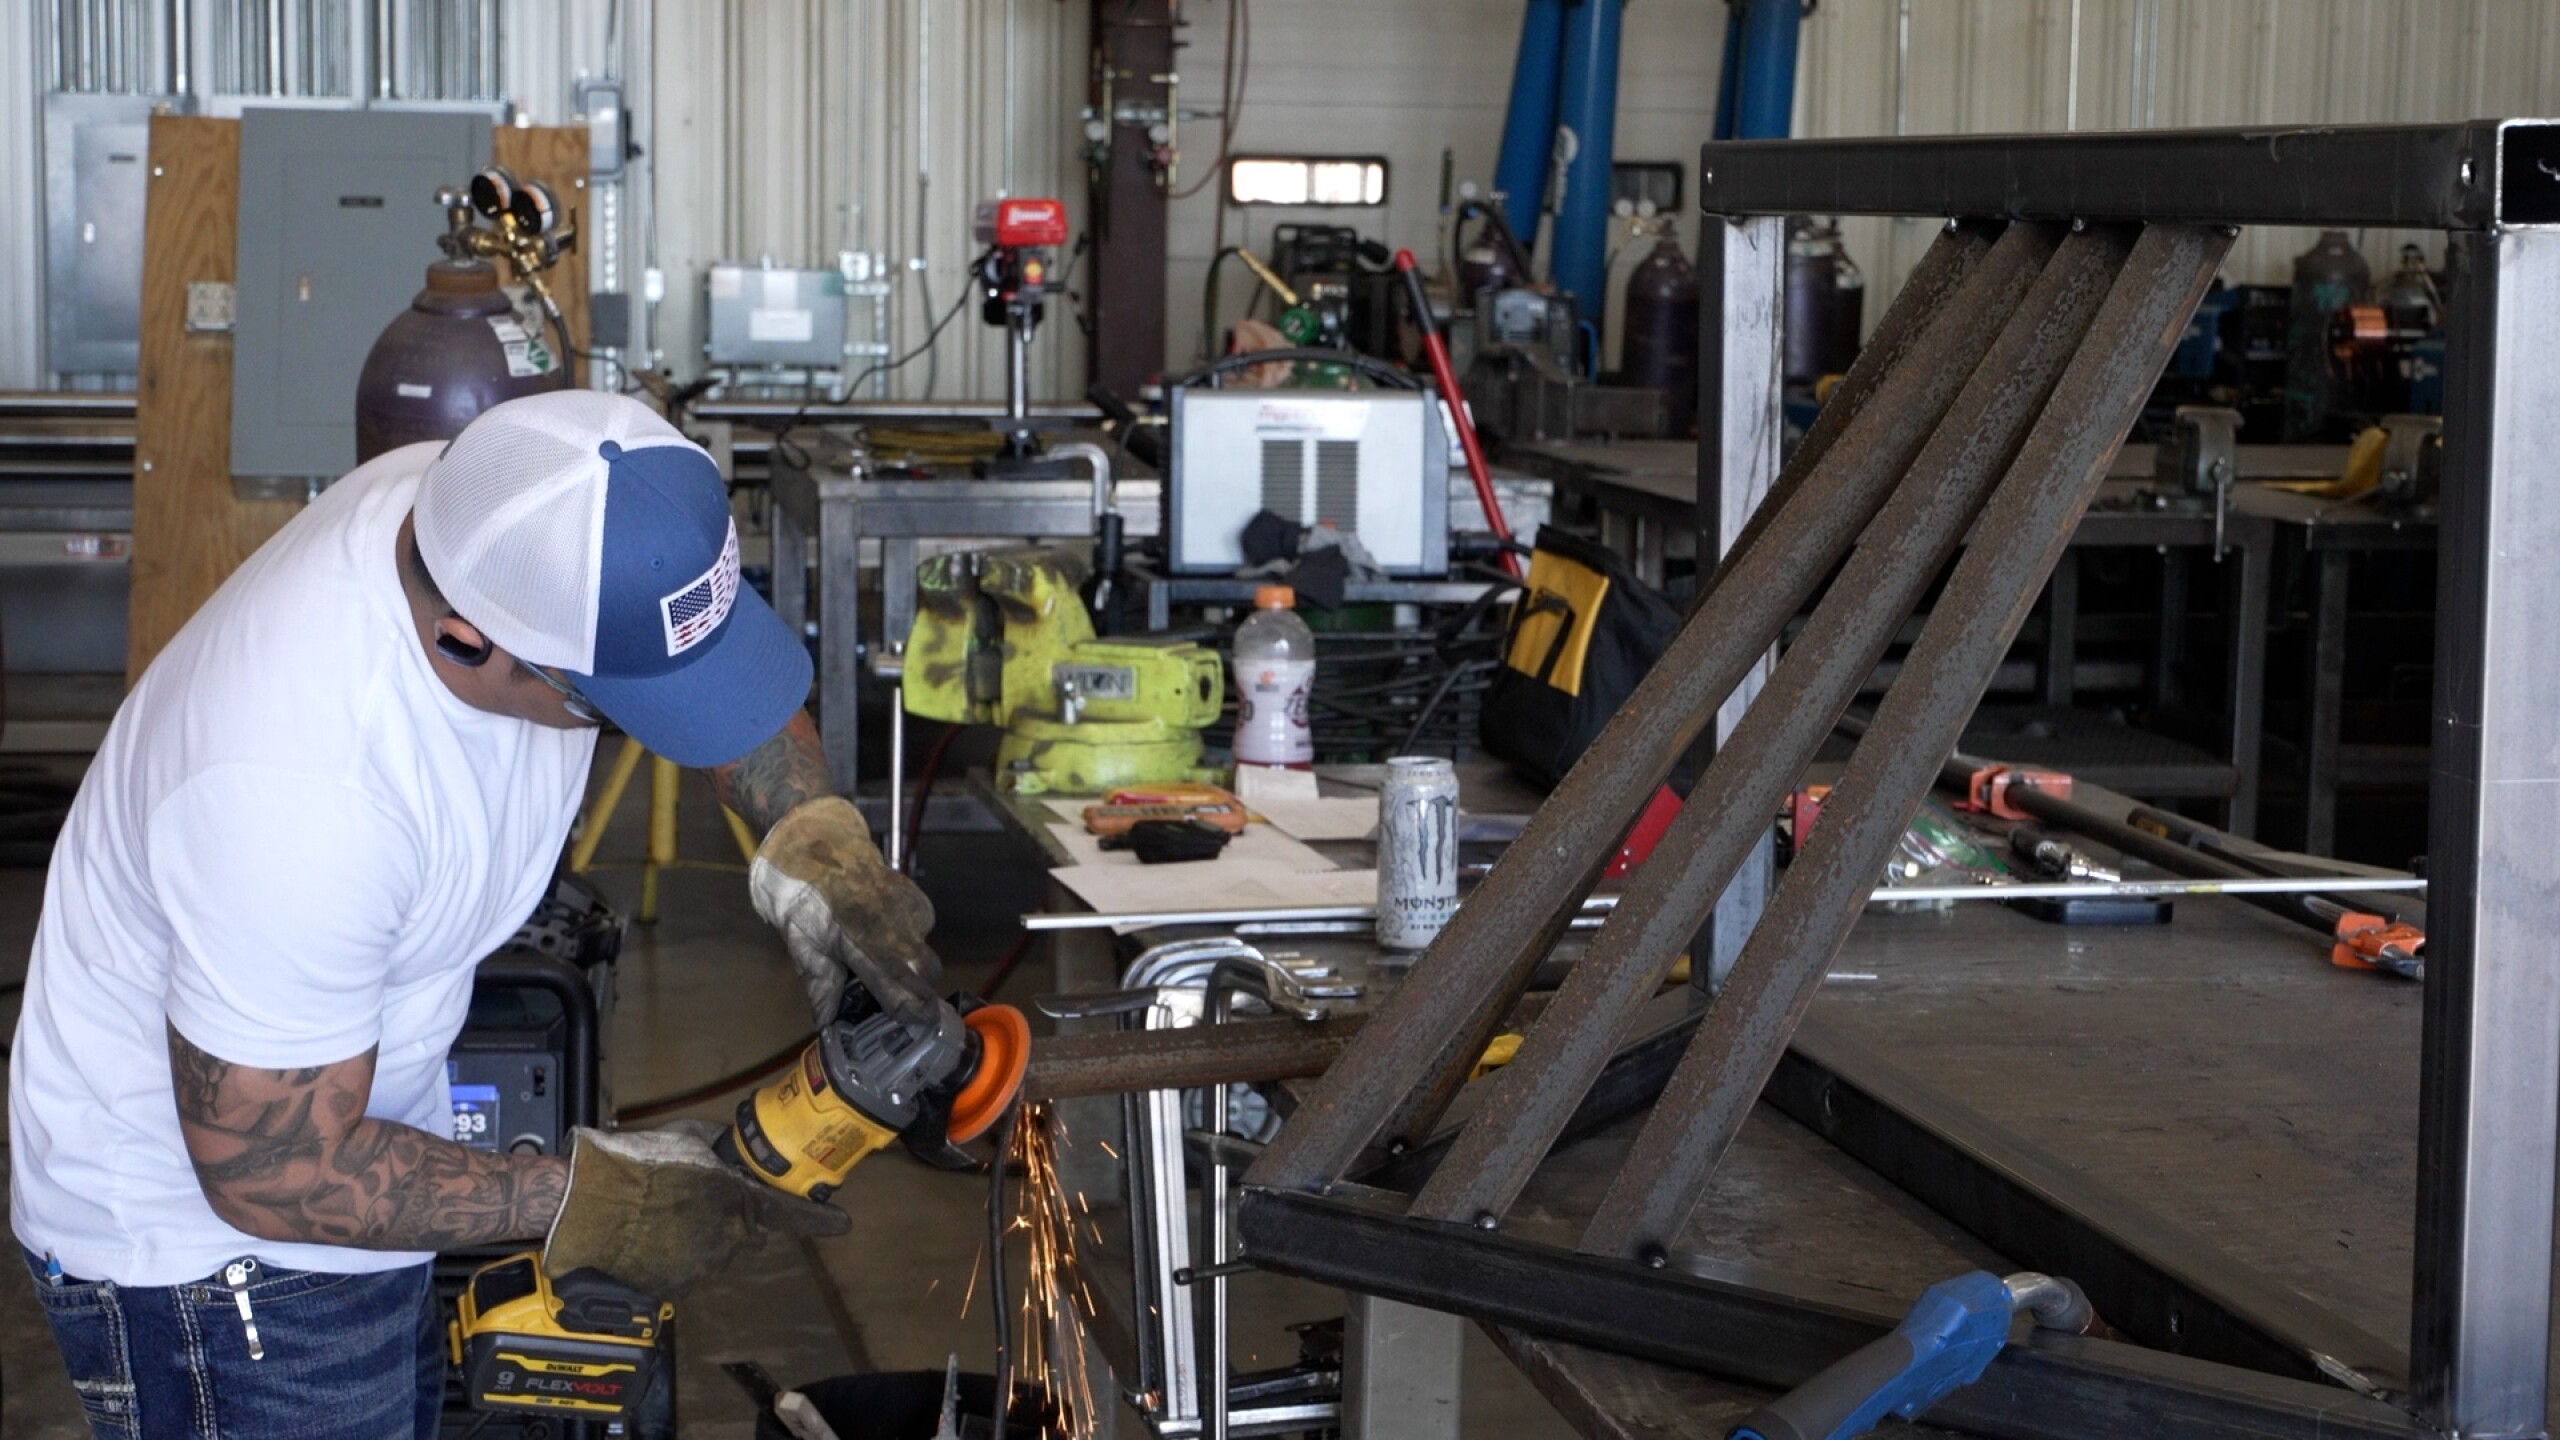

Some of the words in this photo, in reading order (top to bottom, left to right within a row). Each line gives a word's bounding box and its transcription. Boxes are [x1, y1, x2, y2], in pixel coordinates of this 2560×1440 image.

[1395, 895, 1455, 911] MONST
[498, 1371, 516, 1385] 9
[525, 1377, 623, 1396] FLEXVOLT
